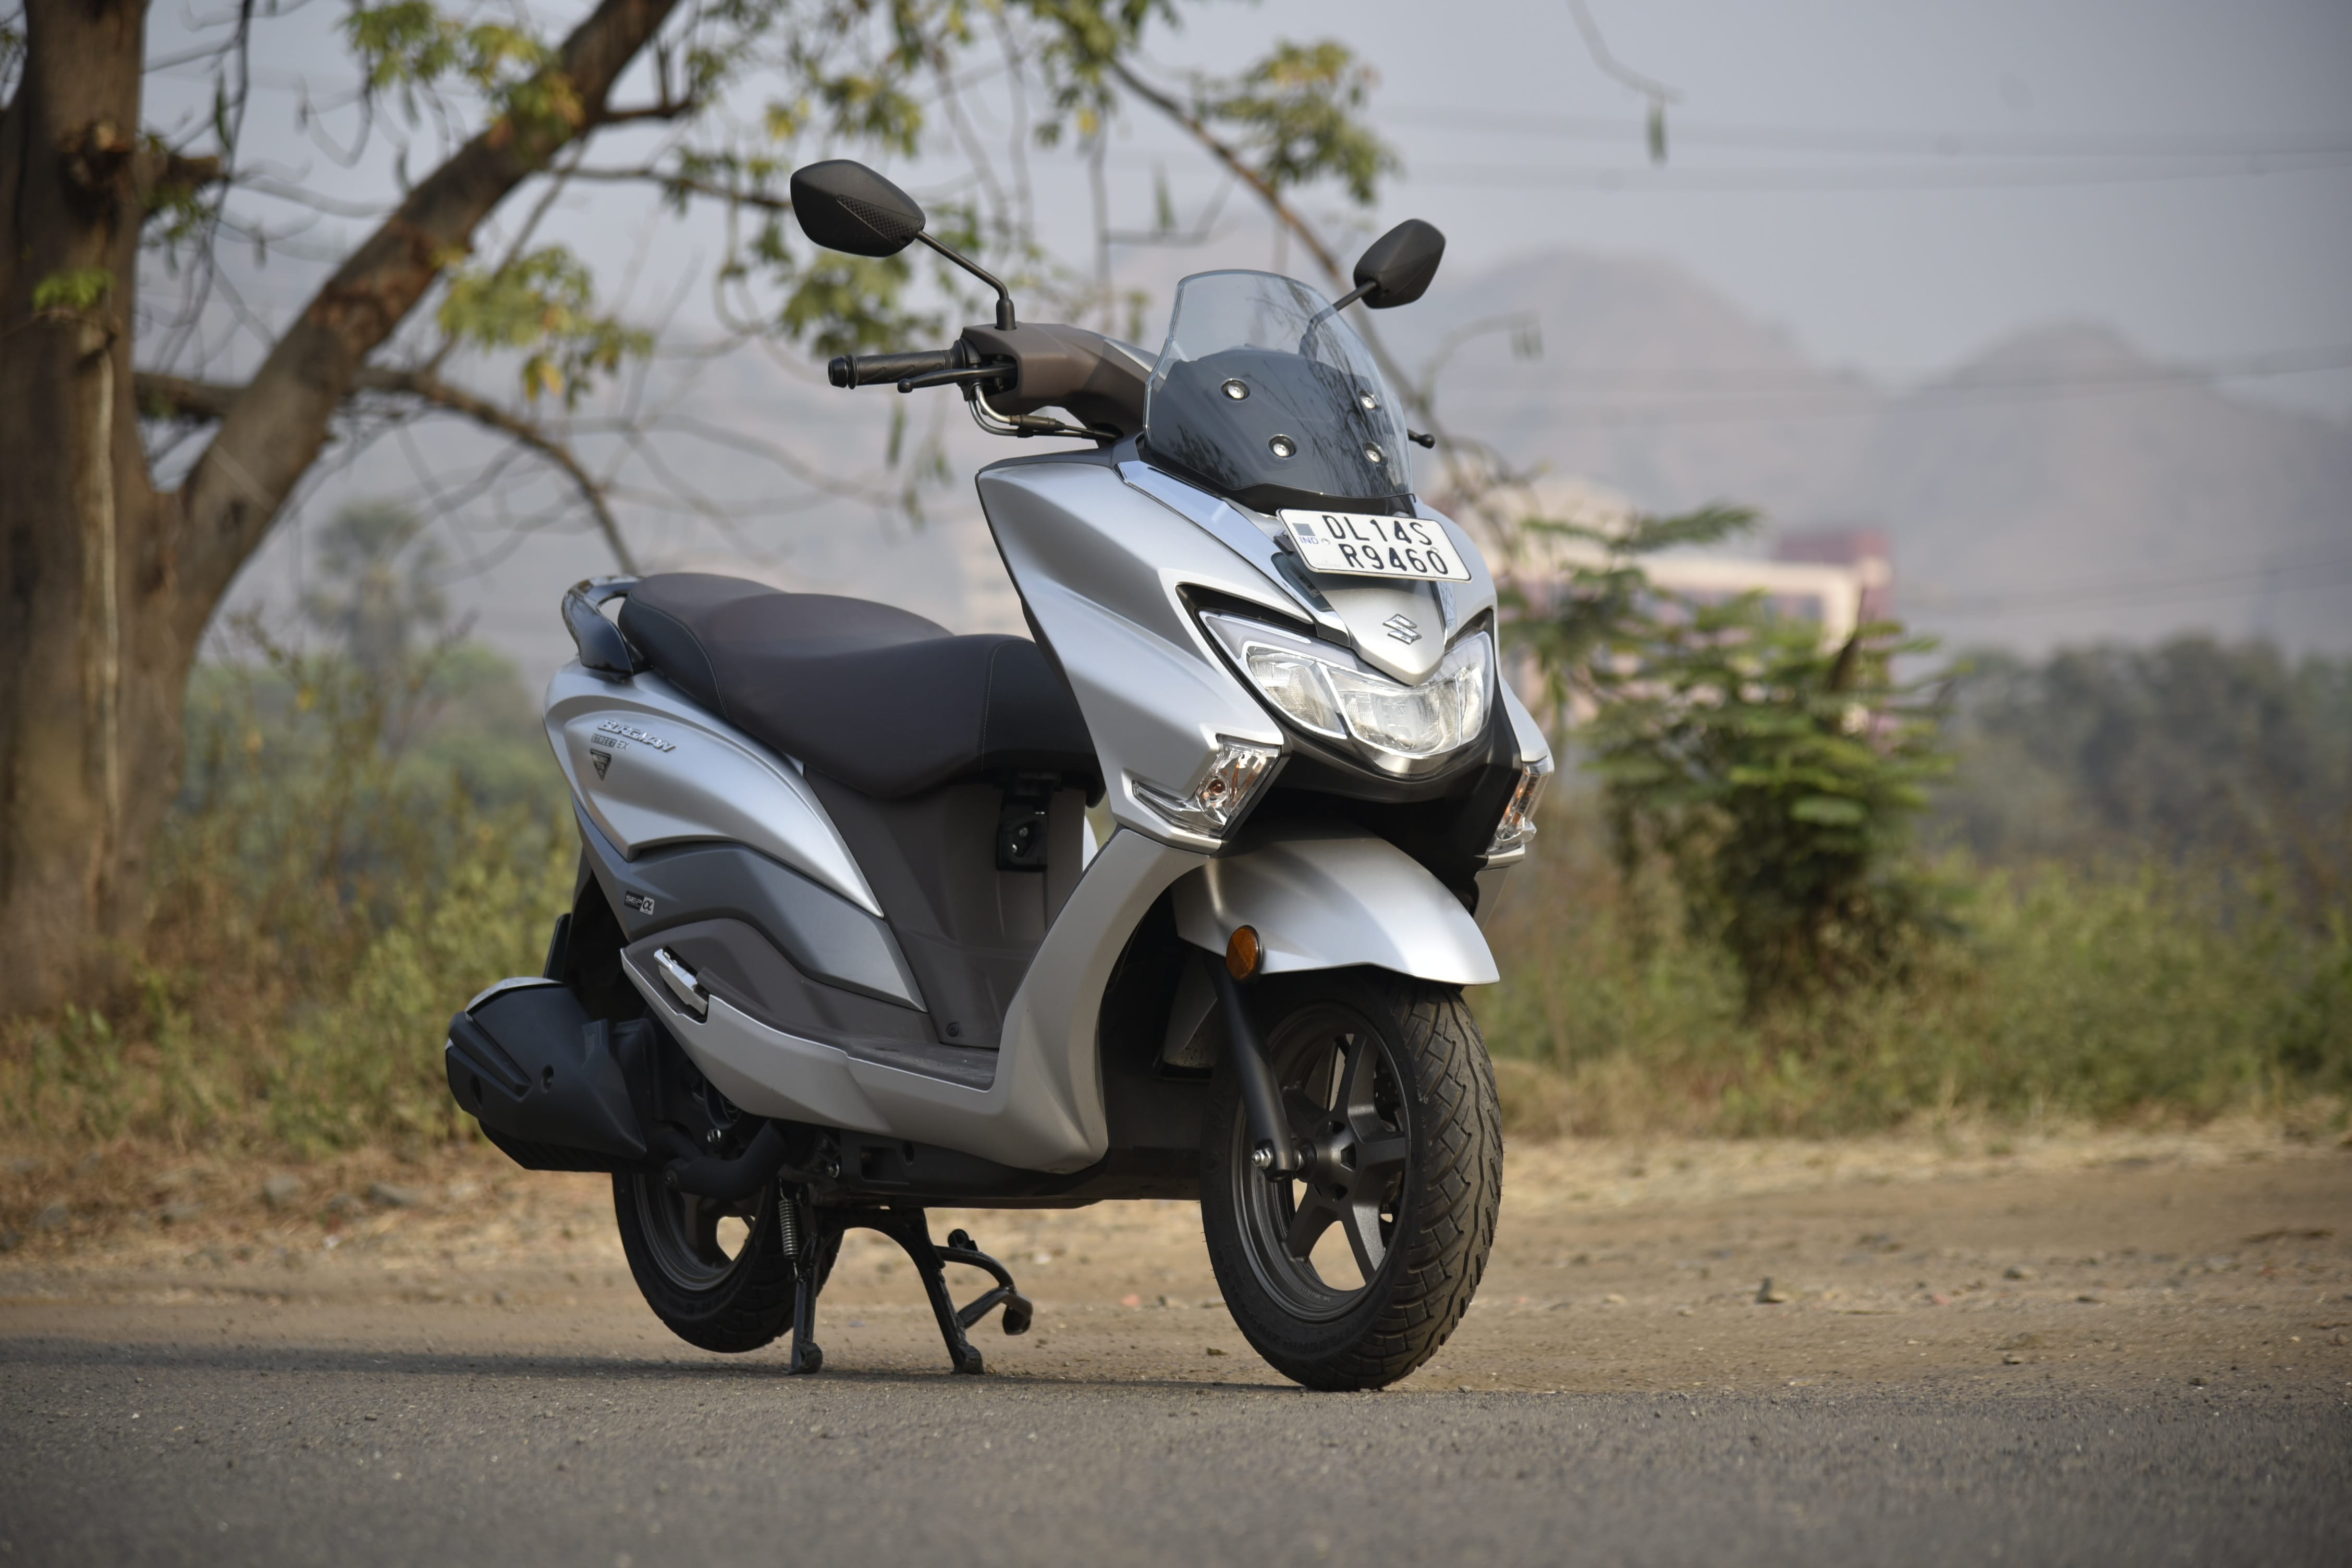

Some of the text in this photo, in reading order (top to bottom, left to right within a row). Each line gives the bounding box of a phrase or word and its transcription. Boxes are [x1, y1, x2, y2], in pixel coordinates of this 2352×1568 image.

[1299, 536, 1319, 545] IND
[1338, 544, 1449, 575] R9460
[591, 734, 630, 750] STREET EX
[597, 719, 677, 752] BURGMAN
[626, 895, 642, 904] SEP
